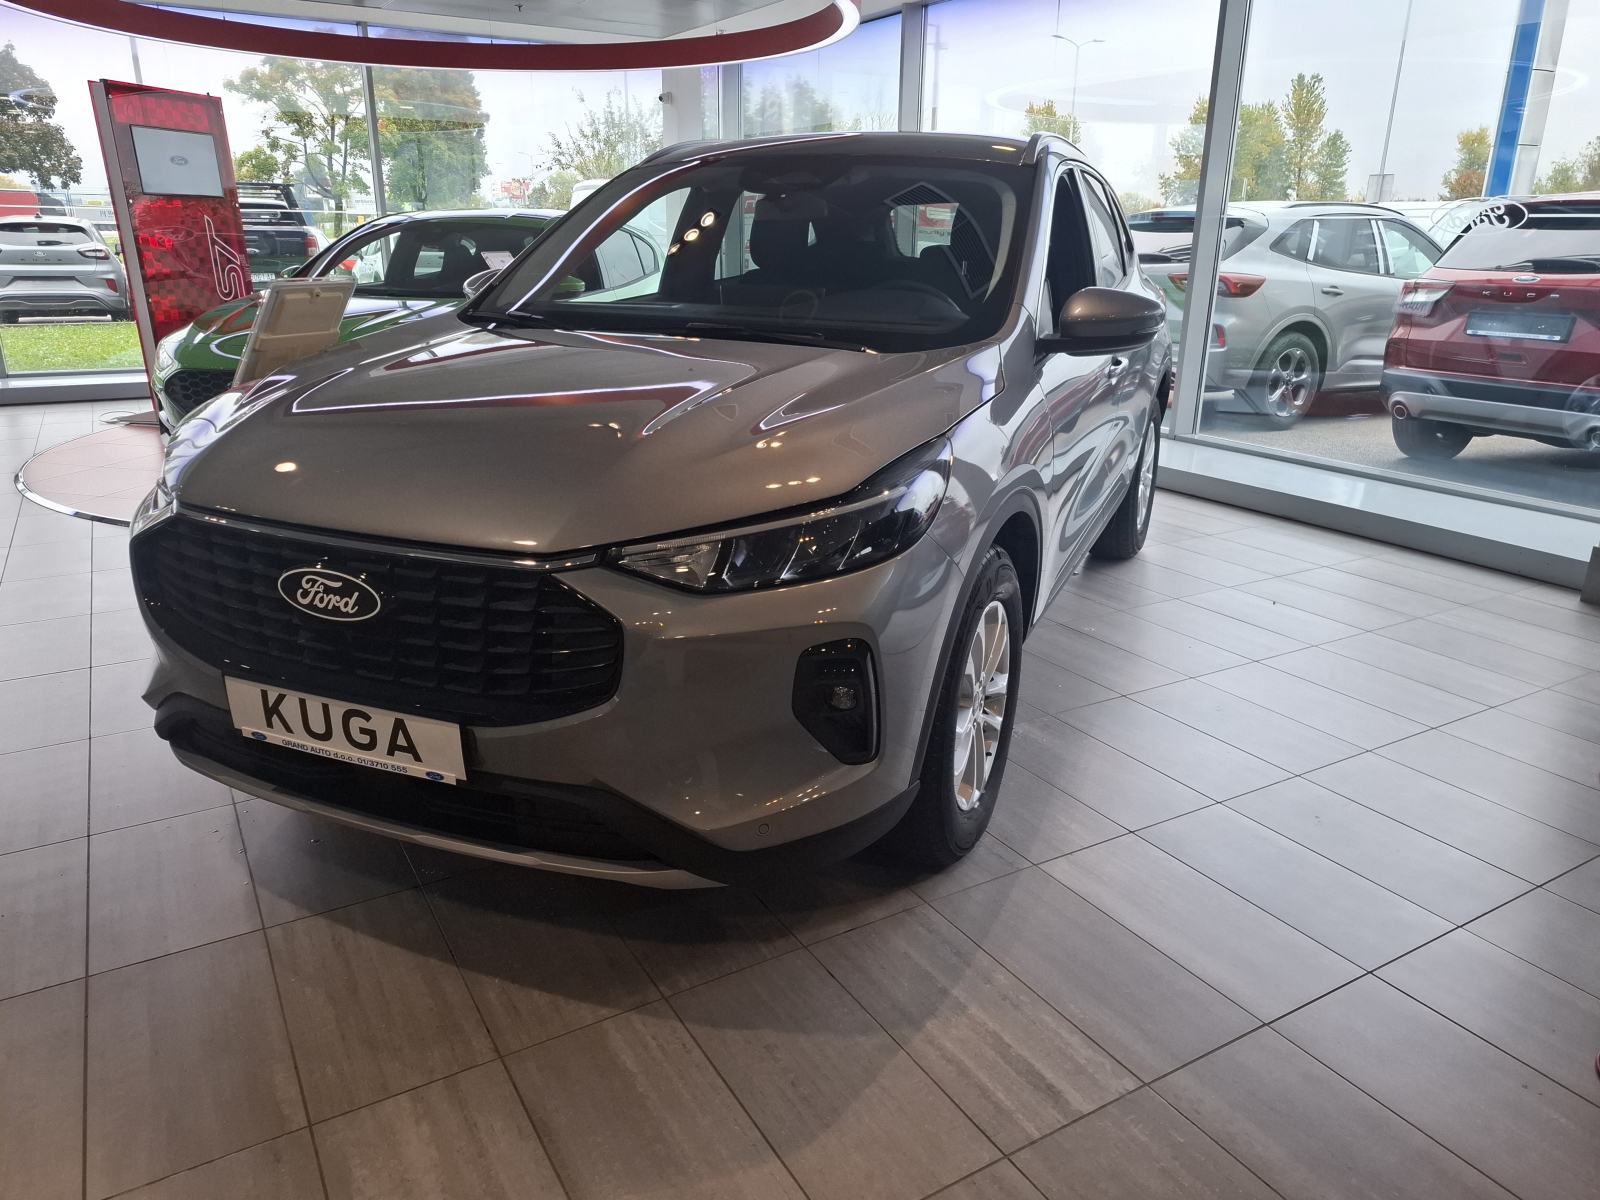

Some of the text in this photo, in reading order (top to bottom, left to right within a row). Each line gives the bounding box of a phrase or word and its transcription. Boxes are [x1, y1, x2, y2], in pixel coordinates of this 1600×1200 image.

[296, 574, 359, 614] Ford
[260, 688, 423, 763] KUGA
[281, 739, 309, 751] GRAND
[310, 746, 331, 757] AUTO
[356, 757, 389, 769] 01/3710
[390, 764, 408, 774] 555
